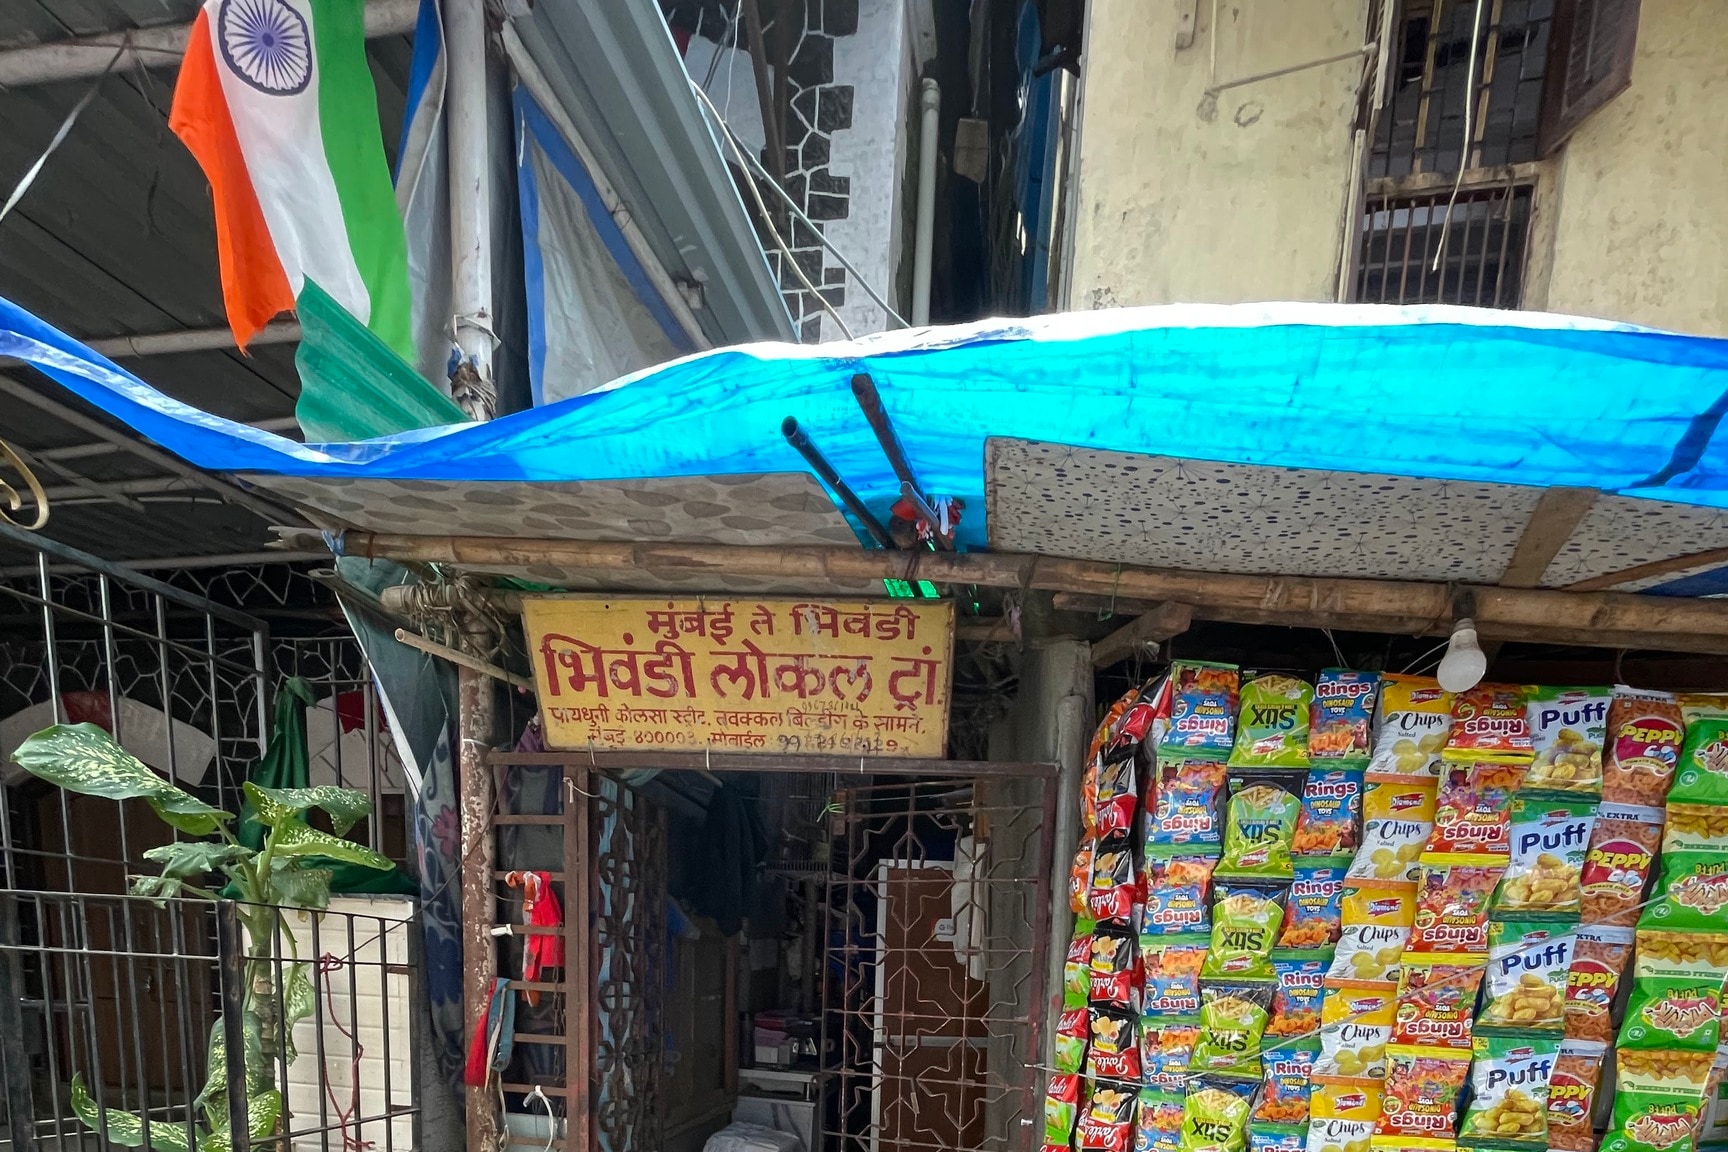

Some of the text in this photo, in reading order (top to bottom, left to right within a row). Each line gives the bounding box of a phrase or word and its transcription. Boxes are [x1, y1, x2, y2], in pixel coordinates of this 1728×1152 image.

[646, 602, 920, 646] मुंबई ते भिवंडी
[539, 632, 698, 699] भिवंडी
[708, 639, 874, 702] लोकल
[1317, 681, 1371, 699] Rings
[615, 703, 667, 725] कोलसा
[713, 710, 783, 729] तवक्कल
[852, 709, 869, 730] के
[1250, 705, 1297, 730] Stix
[1400, 712, 1443, 730] Chips
[1541, 702, 1606, 730] Puff
[1177, 715, 1228, 736] Rings
[1465, 716, 1522, 735] Rings
[1618, 724, 1684, 745] PEPPY
[1305, 781, 1357, 799] Rings
[1162, 815, 1211, 833] Rings
[1606, 812, 1640, 820] EXTRA
[1238, 820, 1282, 844] Stix
[1380, 820, 1422, 839] Chips
[1445, 822, 1502, 841] Rings
[1521, 822, 1586, 855] Puff
[1587, 849, 1651, 870] PEPPY
[1153, 909, 1201, 926] Rings
[1221, 927, 1265, 951] Stix
[1358, 926, 1399, 944] Chips
[1423, 925, 1480, 943] Rings
[1576, 933, 1602, 942] XTRA
[1501, 943, 1567, 975] Puff
[1284, 972, 1325, 989] Ring
[1568, 971, 1618, 988] EPPY
[1151, 996, 1197, 1010] Rings
[1341, 1025, 1380, 1041] Chips
[1407, 1019, 1463, 1037] Rings
[1275, 1061, 1312, 1077] Ring
[1487, 1060, 1552, 1090] Puff
[1151, 1072, 1185, 1086] ings
[1549, 1085, 1593, 1099] PPY
[1648, 1103, 1677, 1115] PUFFS
[1327, 1120, 1365, 1137] Chips
[1391, 1112, 1446, 1130] Rings
